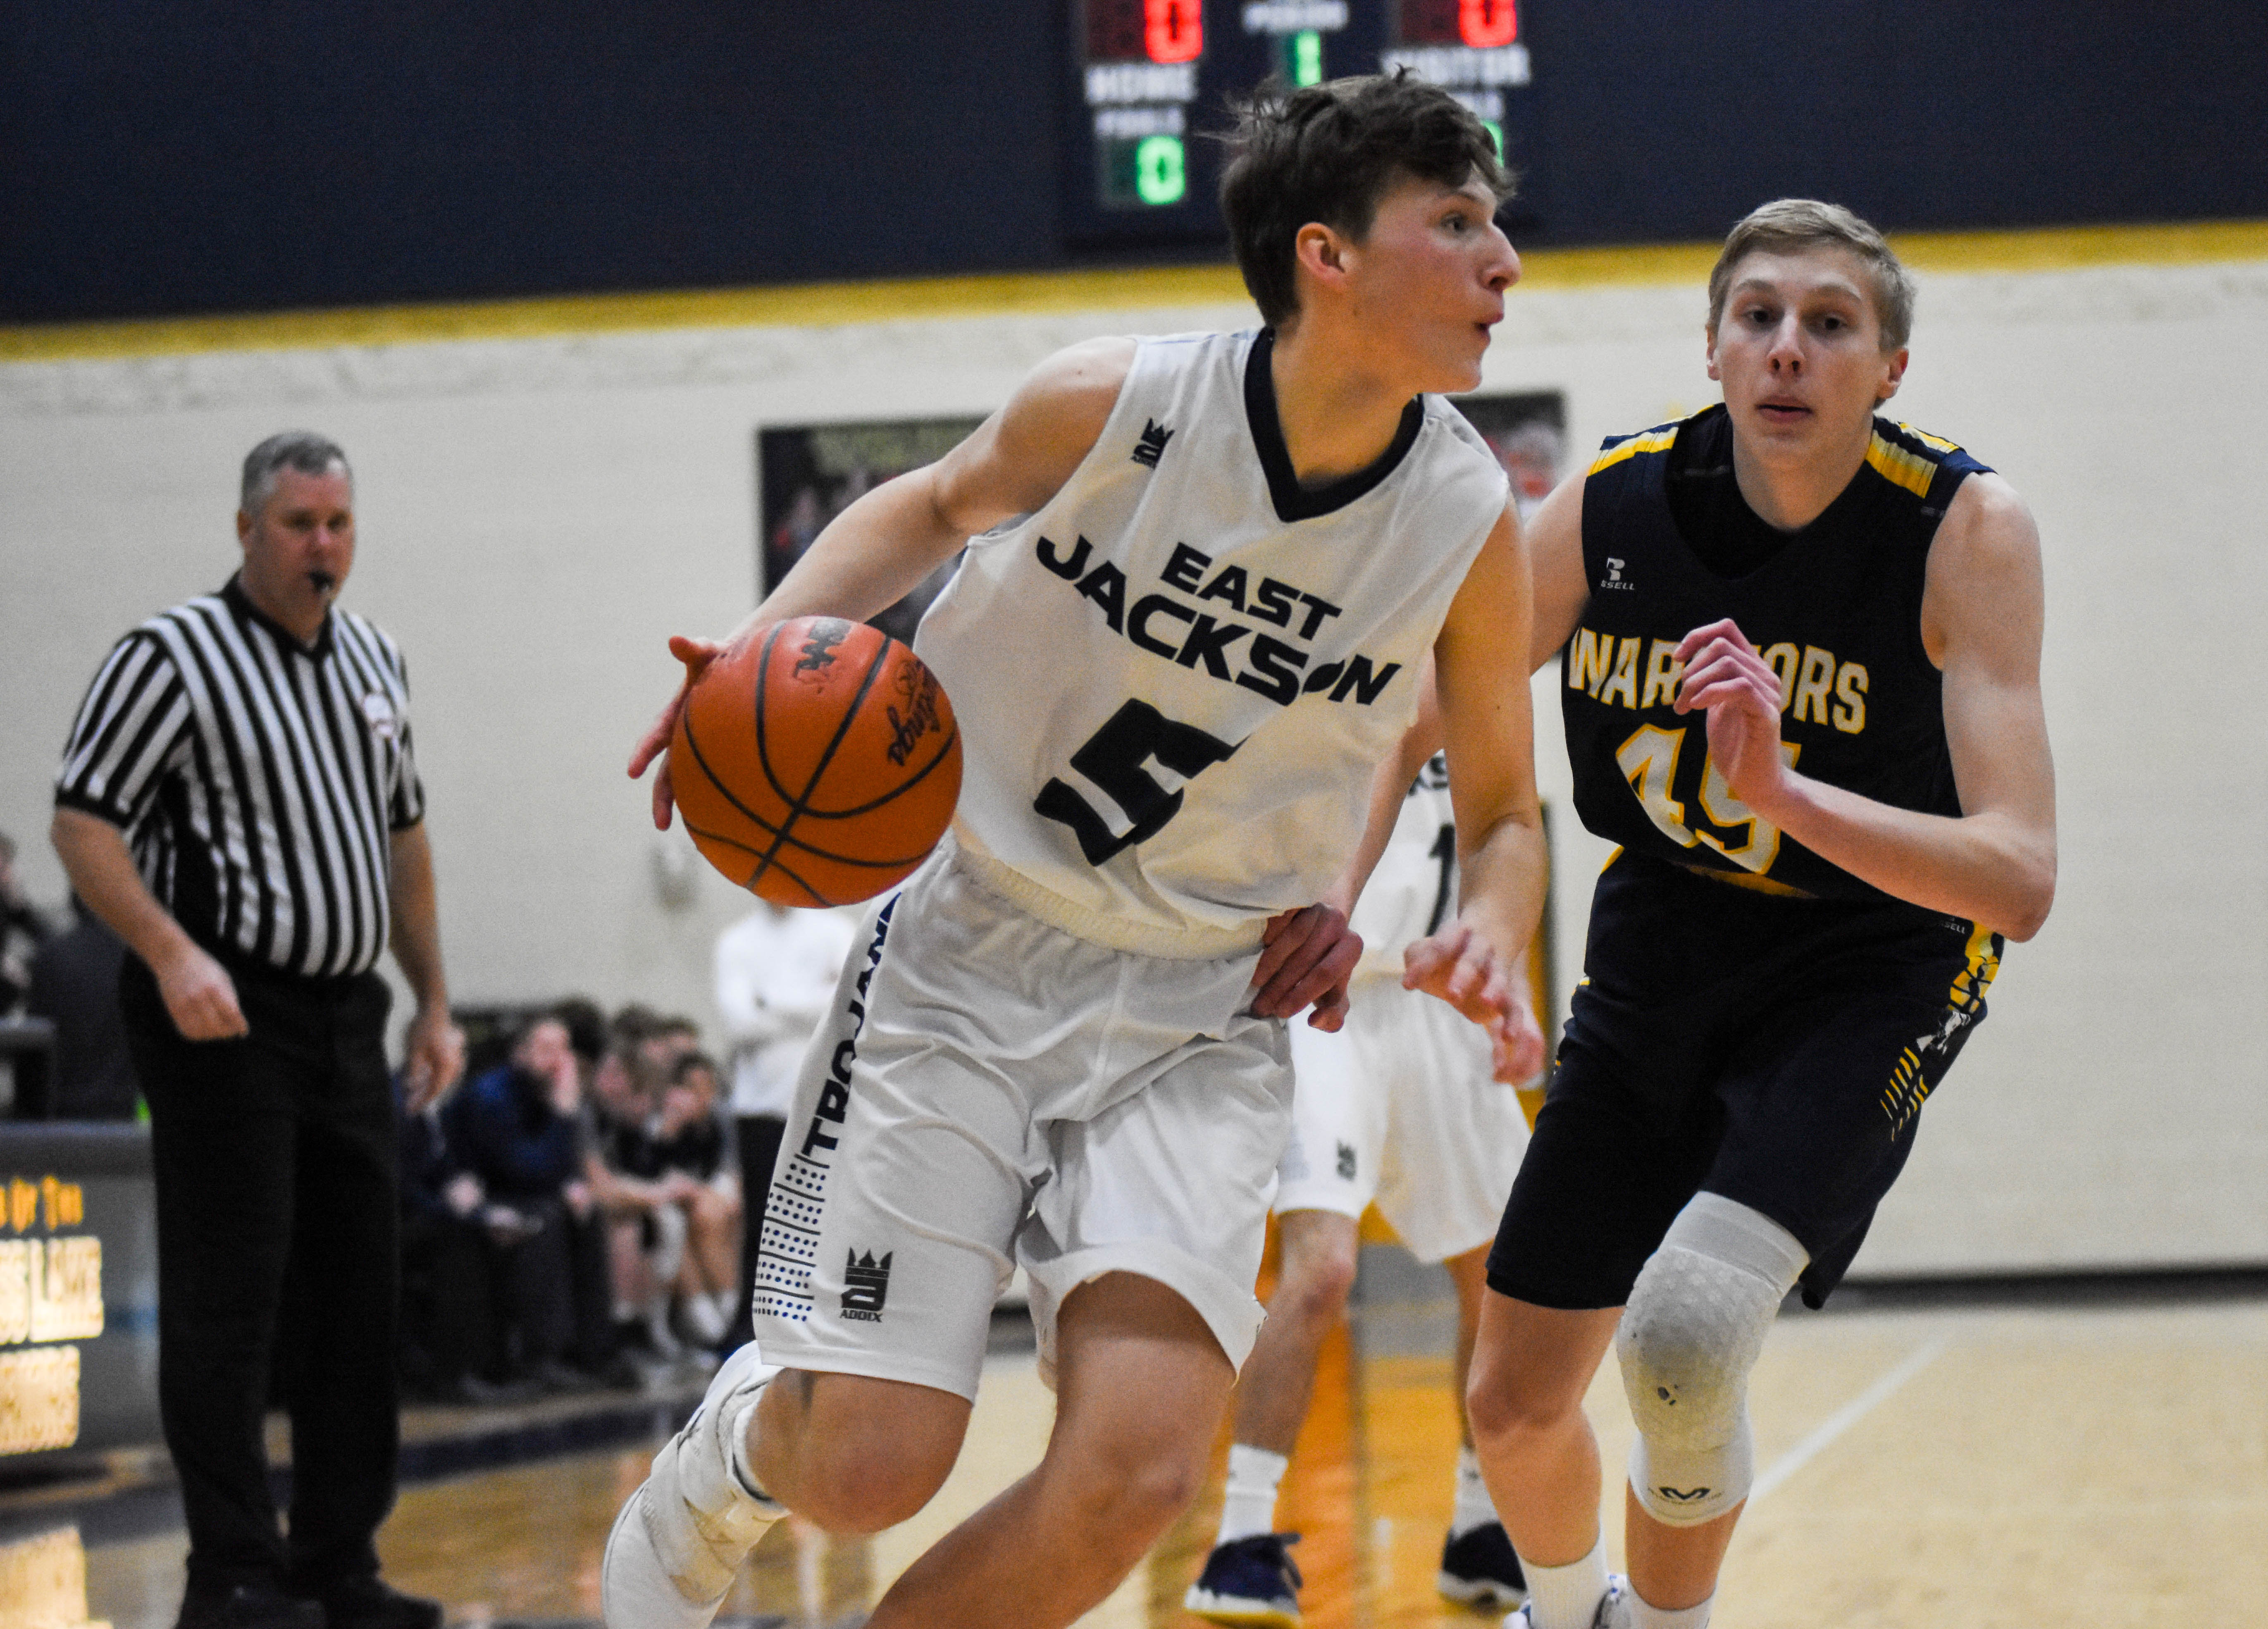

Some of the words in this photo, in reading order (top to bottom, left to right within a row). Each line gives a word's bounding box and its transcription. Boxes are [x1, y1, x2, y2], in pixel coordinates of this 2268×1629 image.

[1135, 134, 1184, 204] 0
[1160, 542, 1343, 641] EAST
[1569, 627, 1869, 735] WARORS
[1033, 697, 1252, 867] 5
[839, 1309, 882, 1323] ADDIX
